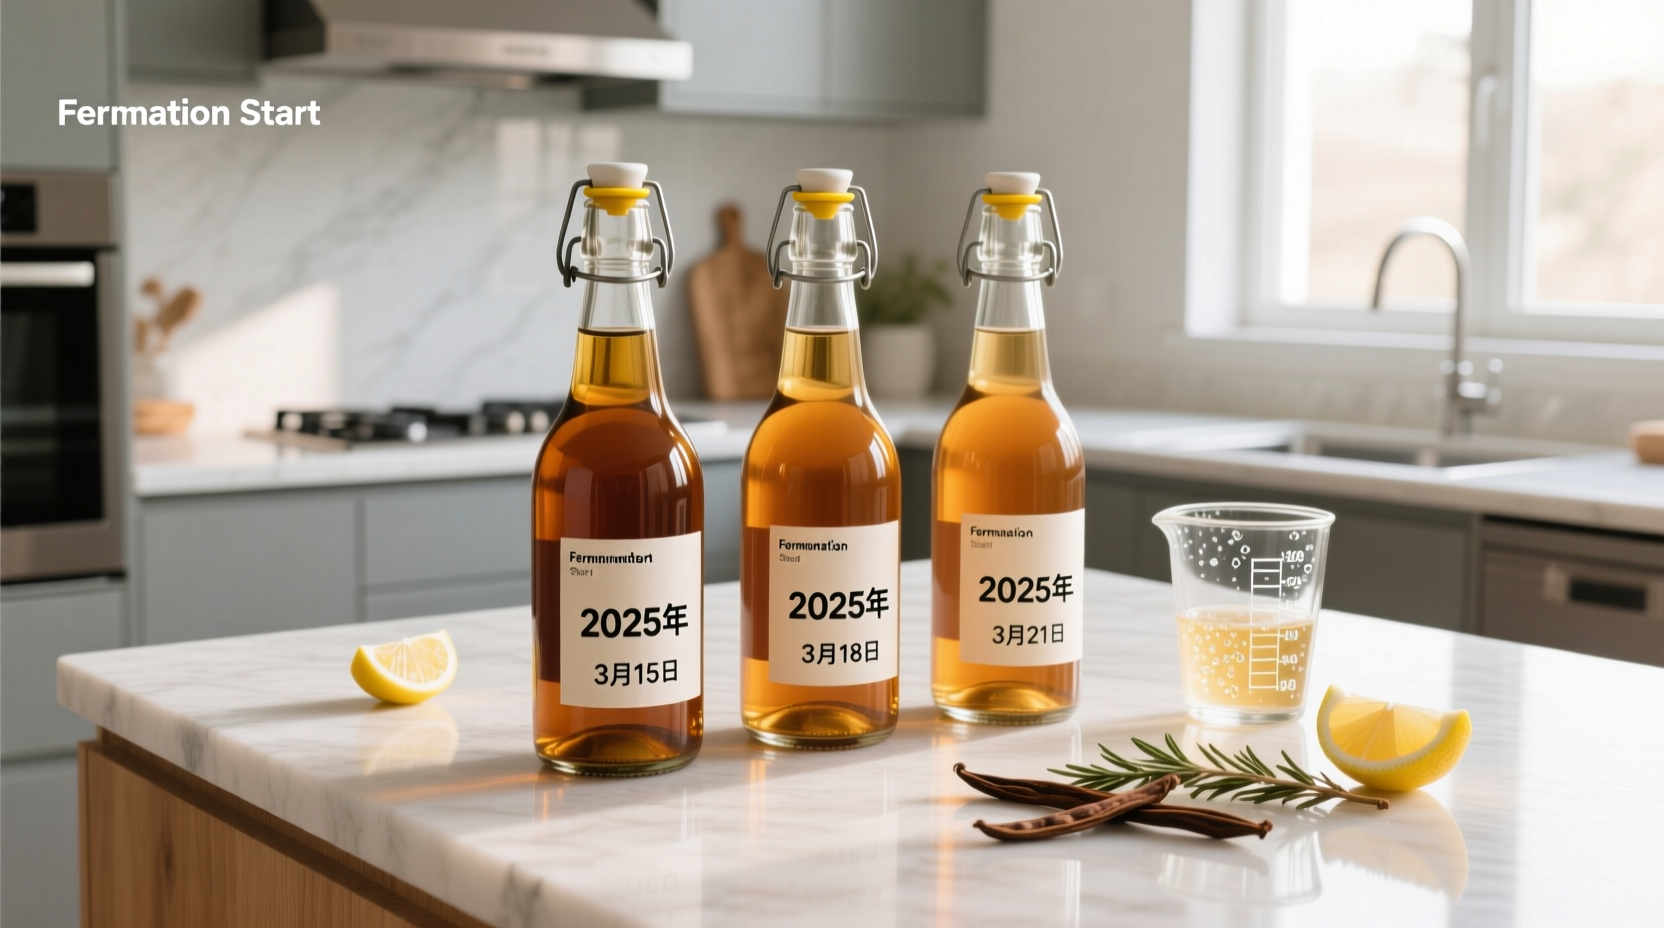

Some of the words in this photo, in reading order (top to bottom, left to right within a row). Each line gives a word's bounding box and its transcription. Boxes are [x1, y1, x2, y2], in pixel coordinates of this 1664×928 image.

[788, 587, 890, 621] 2025年
[978, 573, 1074, 605] 2025年
[580, 603, 689, 639] 2025年
[992, 623, 1064, 647] 3月21日
[801, 640, 879, 666] 3月18日
[594, 659, 678, 687] 3月15日
